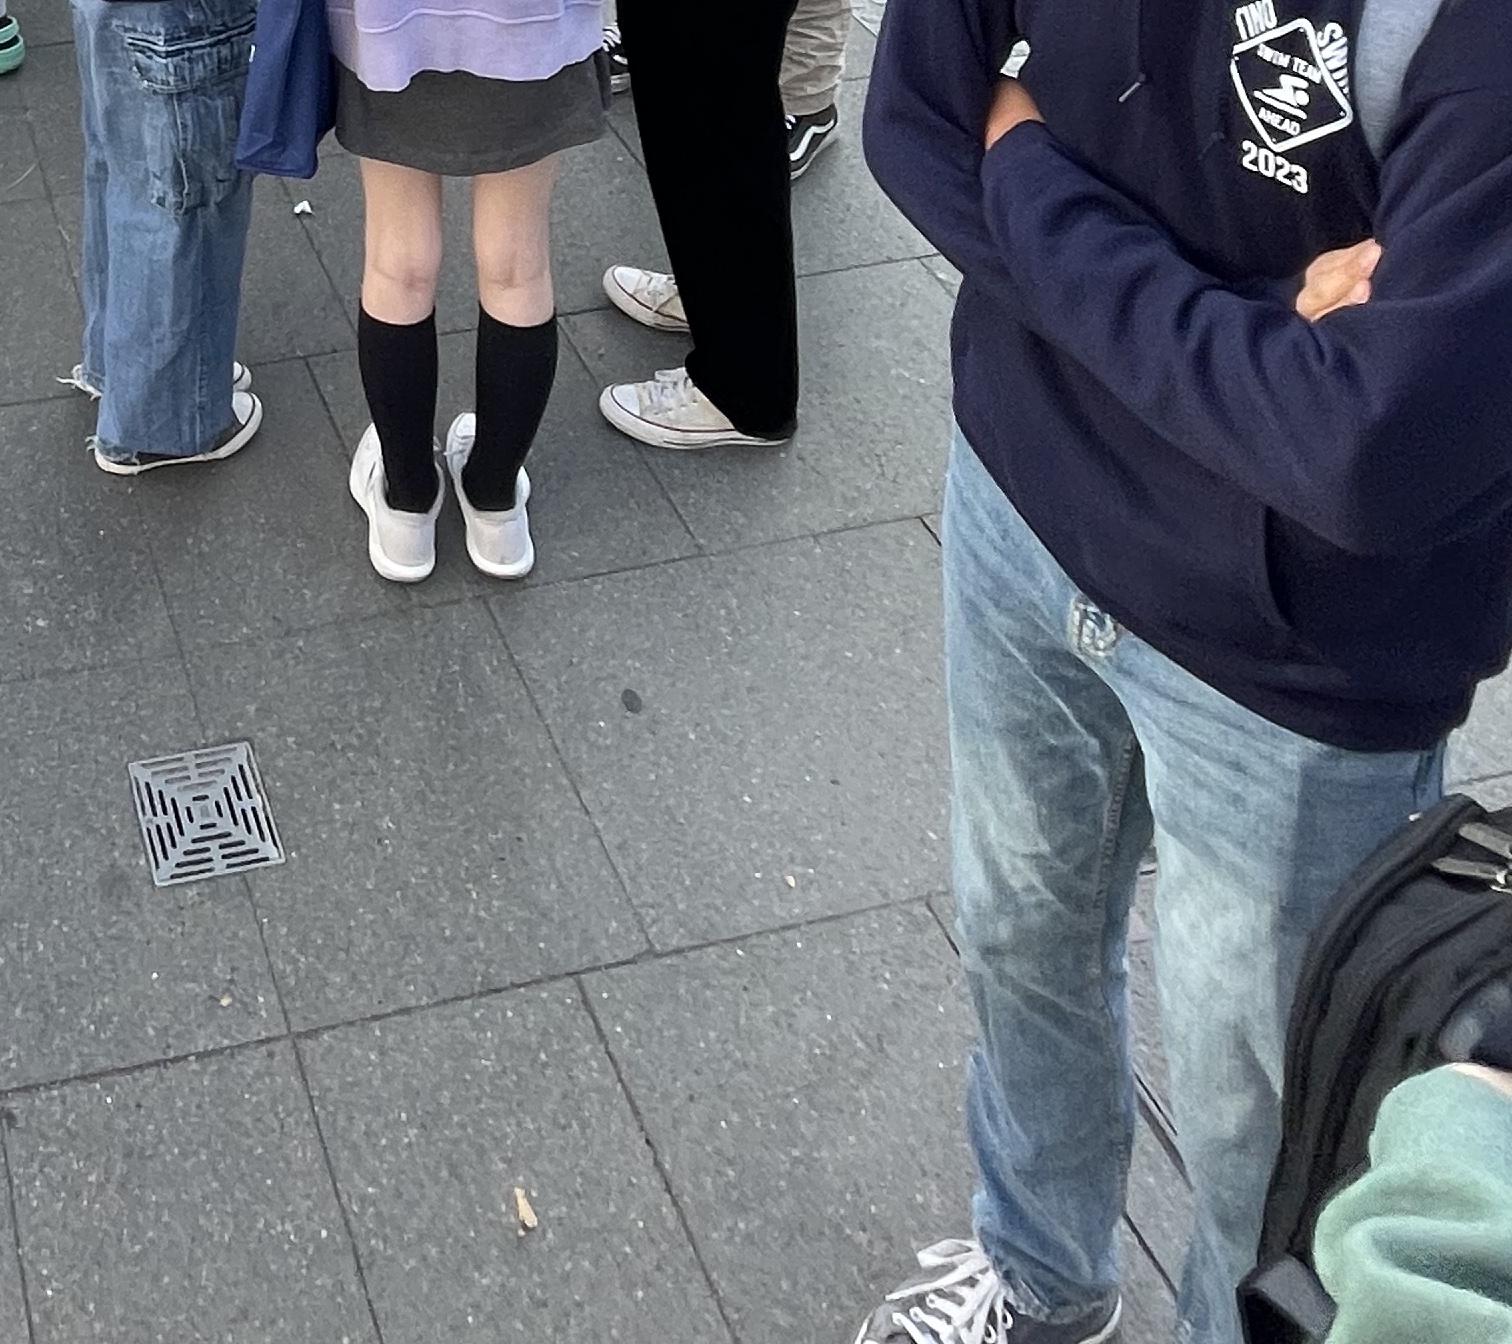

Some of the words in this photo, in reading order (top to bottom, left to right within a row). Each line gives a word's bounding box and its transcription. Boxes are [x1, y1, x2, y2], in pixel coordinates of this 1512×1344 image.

[1292, 57, 1322, 83] TEAM
[1258, 107, 1301, 135] AHEAD
[1241, 140, 1308, 194] 2023
